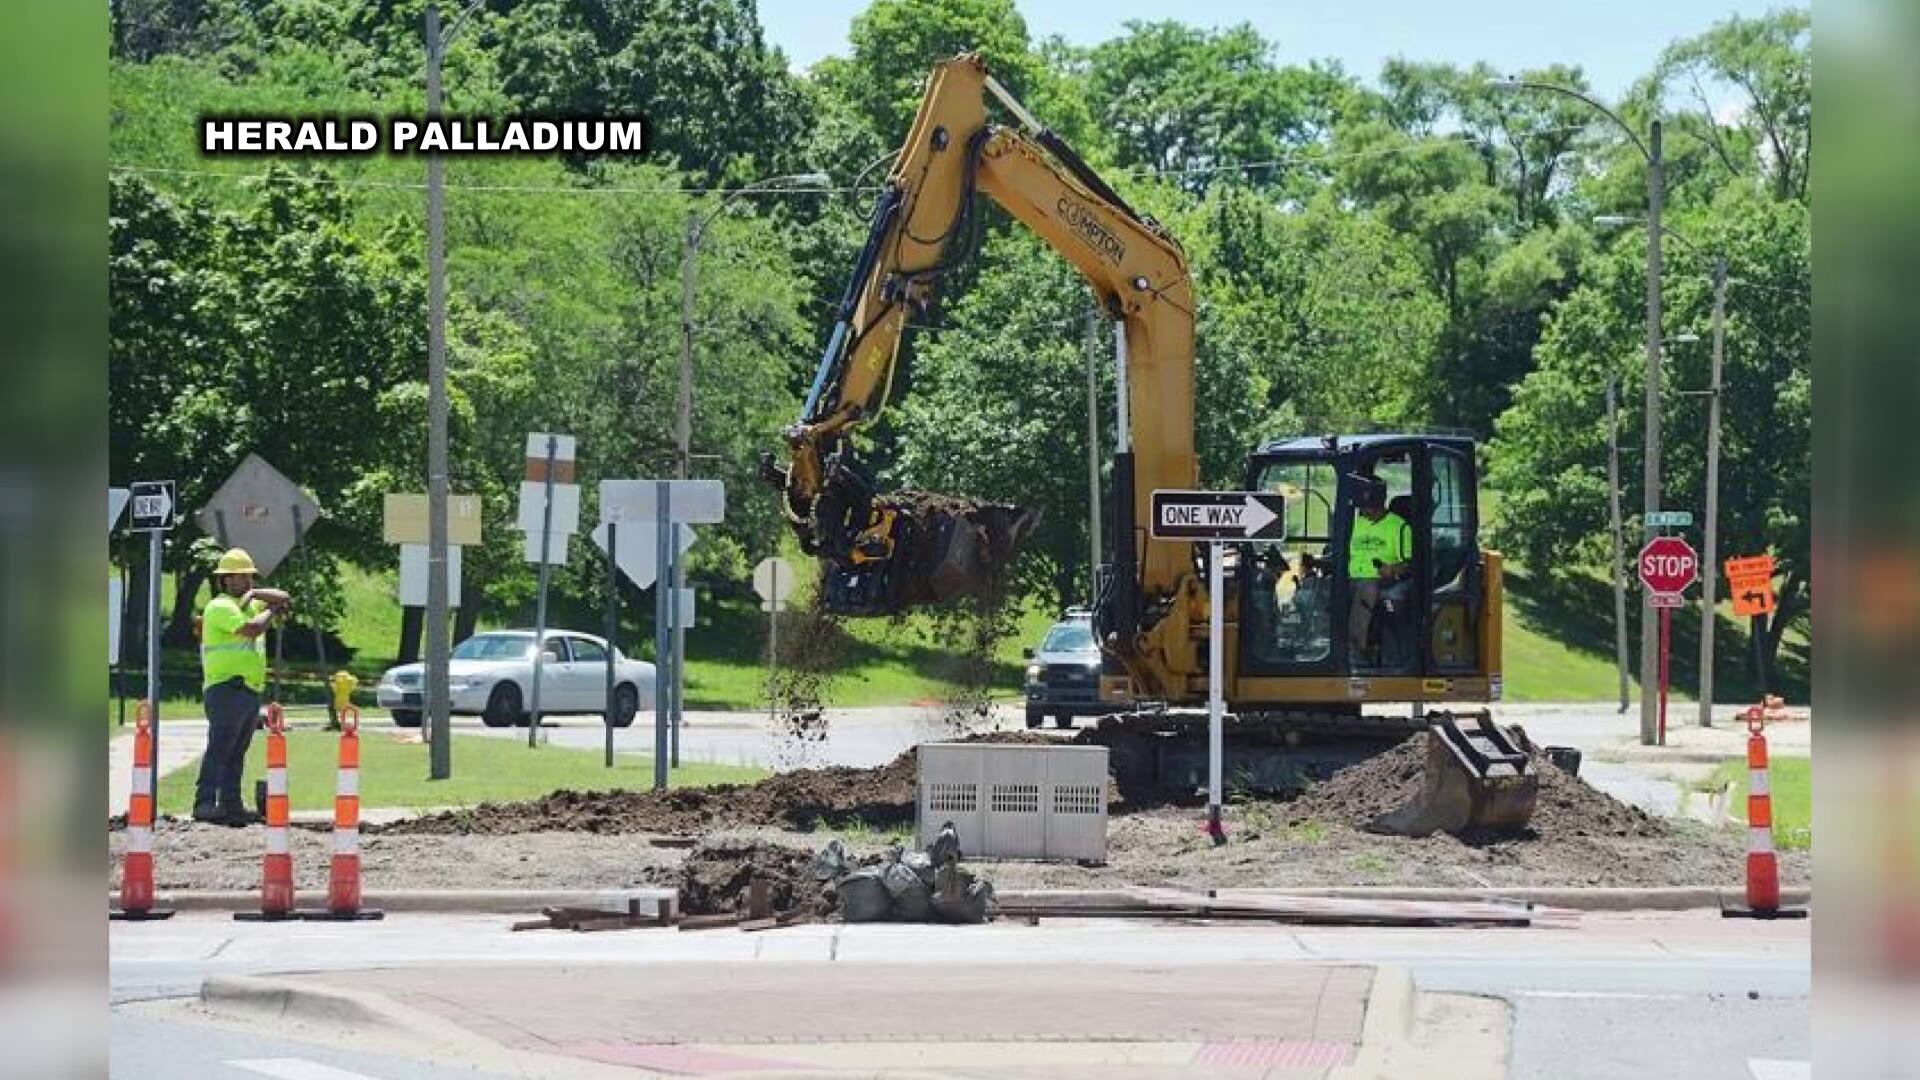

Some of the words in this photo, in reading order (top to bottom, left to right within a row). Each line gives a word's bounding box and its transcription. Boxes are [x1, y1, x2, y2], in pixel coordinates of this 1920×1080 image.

[1056, 197, 1126, 263] COMPTON
[1165, 506, 1201, 524] ONE
[1206, 506, 1243, 524] WAY
[1644, 555, 1693, 576] STOP
